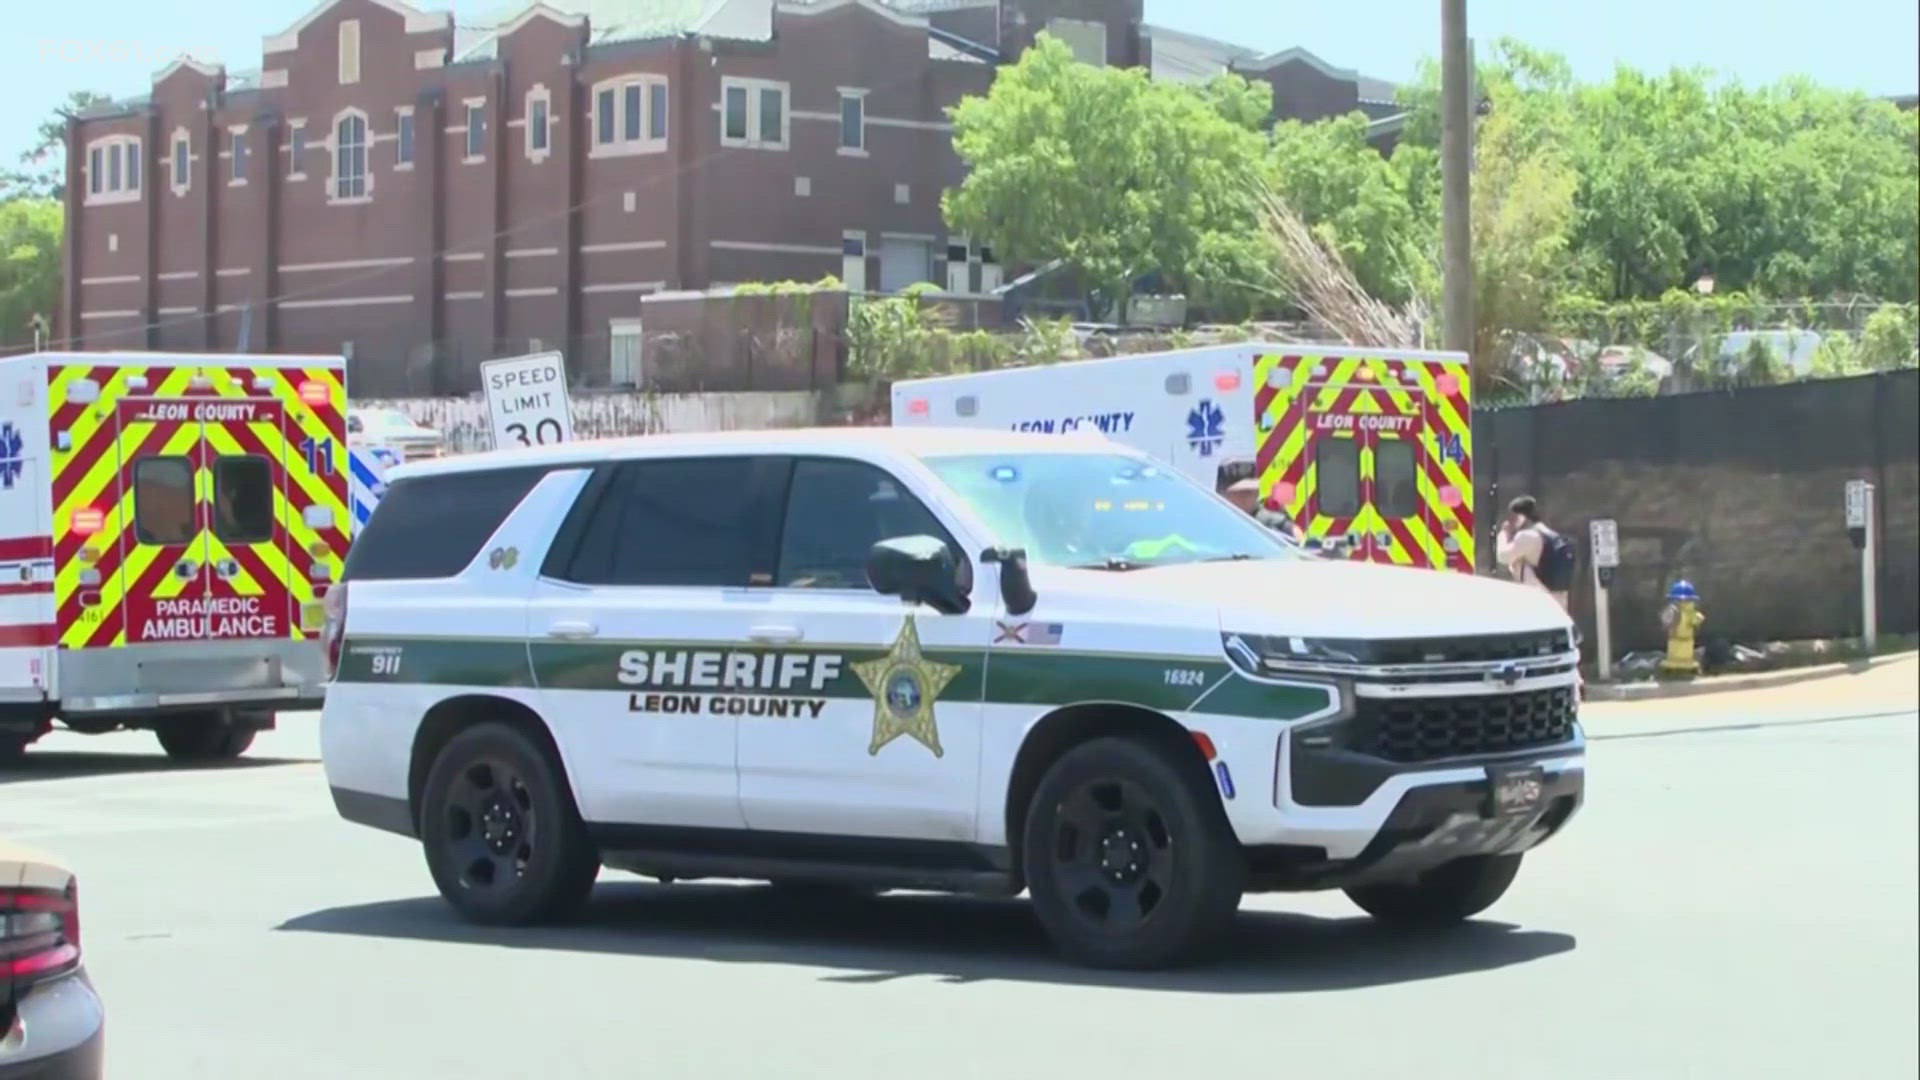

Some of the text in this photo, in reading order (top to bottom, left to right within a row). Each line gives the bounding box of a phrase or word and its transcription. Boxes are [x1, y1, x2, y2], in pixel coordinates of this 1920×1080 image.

[491, 366, 557, 390] SPEED
[148, 404, 256, 420] LEON COUNTY
[501, 392, 551, 414] LIMIT
[1316, 414, 1414, 431] LEON COUNTY
[302, 436, 334, 475] 11
[1435, 431, 1466, 466] 14
[156, 597, 260, 616] PARAMEDIC
[141, 615, 276, 639] AMBULANCE
[371, 654, 401, 675] 911
[616, 650, 843, 690] SHERIFF
[628, 693, 826, 719] LEON COUNTY
